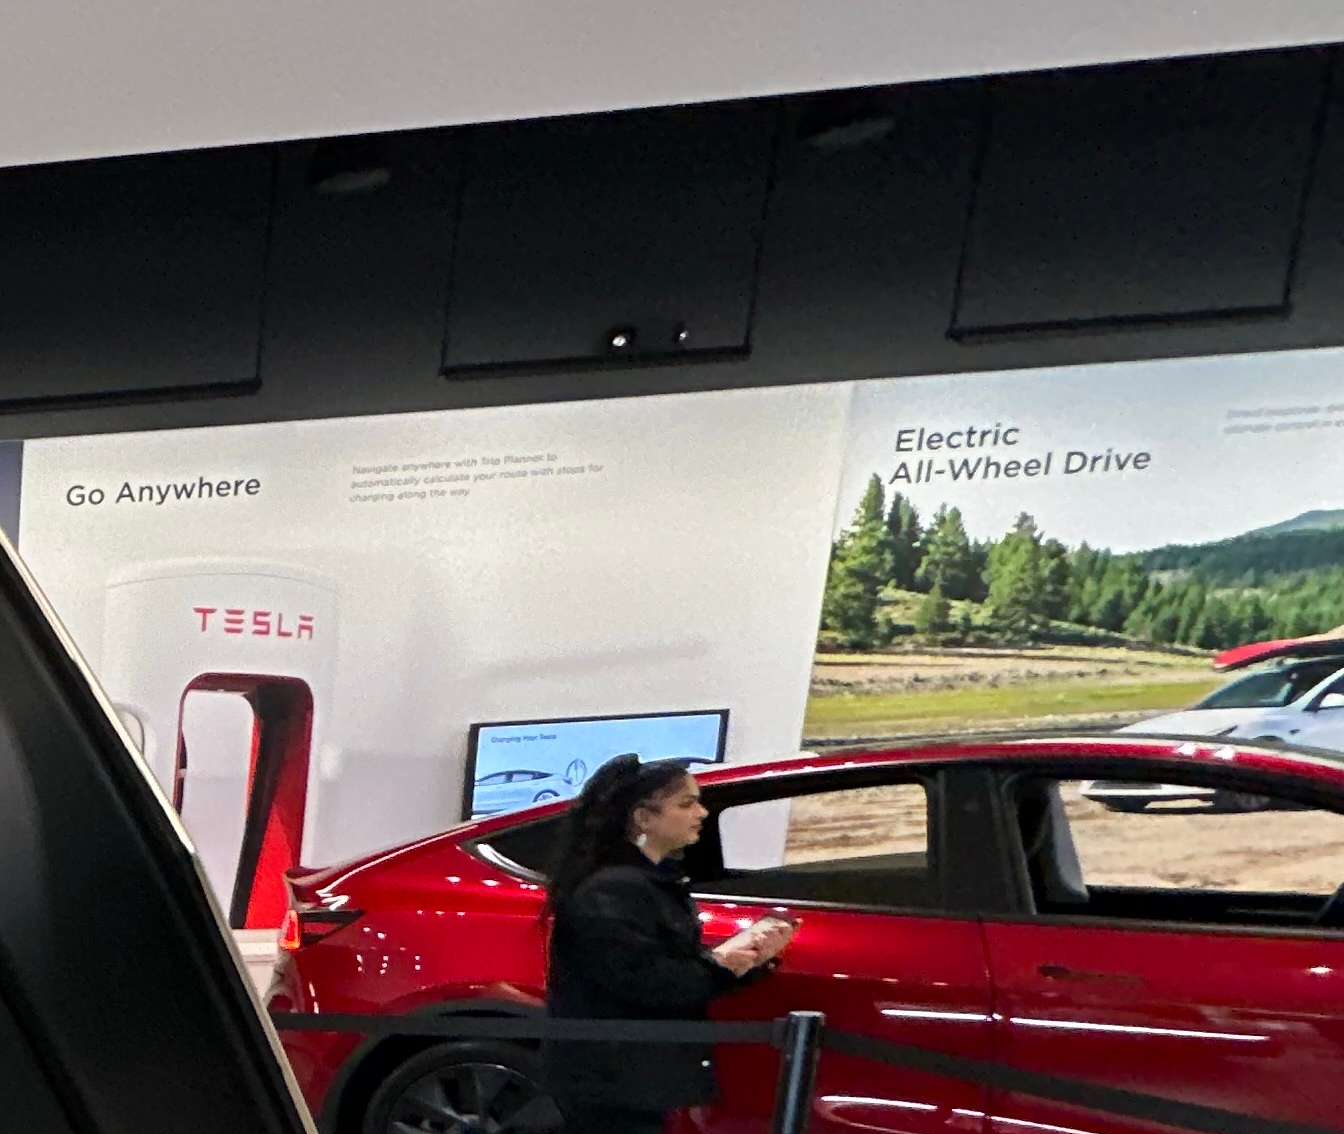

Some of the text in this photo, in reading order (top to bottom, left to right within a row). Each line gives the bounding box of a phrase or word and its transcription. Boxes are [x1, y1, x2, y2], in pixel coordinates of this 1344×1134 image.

[894, 422, 1020, 452] Electric
[423, 474, 470, 484] calculate
[473, 473, 496, 483] your
[500, 470, 528, 479] route
[530, 467, 553, 476] with
[454, 458, 478, 468] with
[546, 453, 558, 462] to
[888, 448, 1151, 485] All-Wheel Drive
[66, 476, 261, 506] Go Anywhere
[397, 490, 427, 501] along
[430, 489, 447, 498] the
[449, 488, 470, 498] way
[192, 606, 314, 640] TESLA
